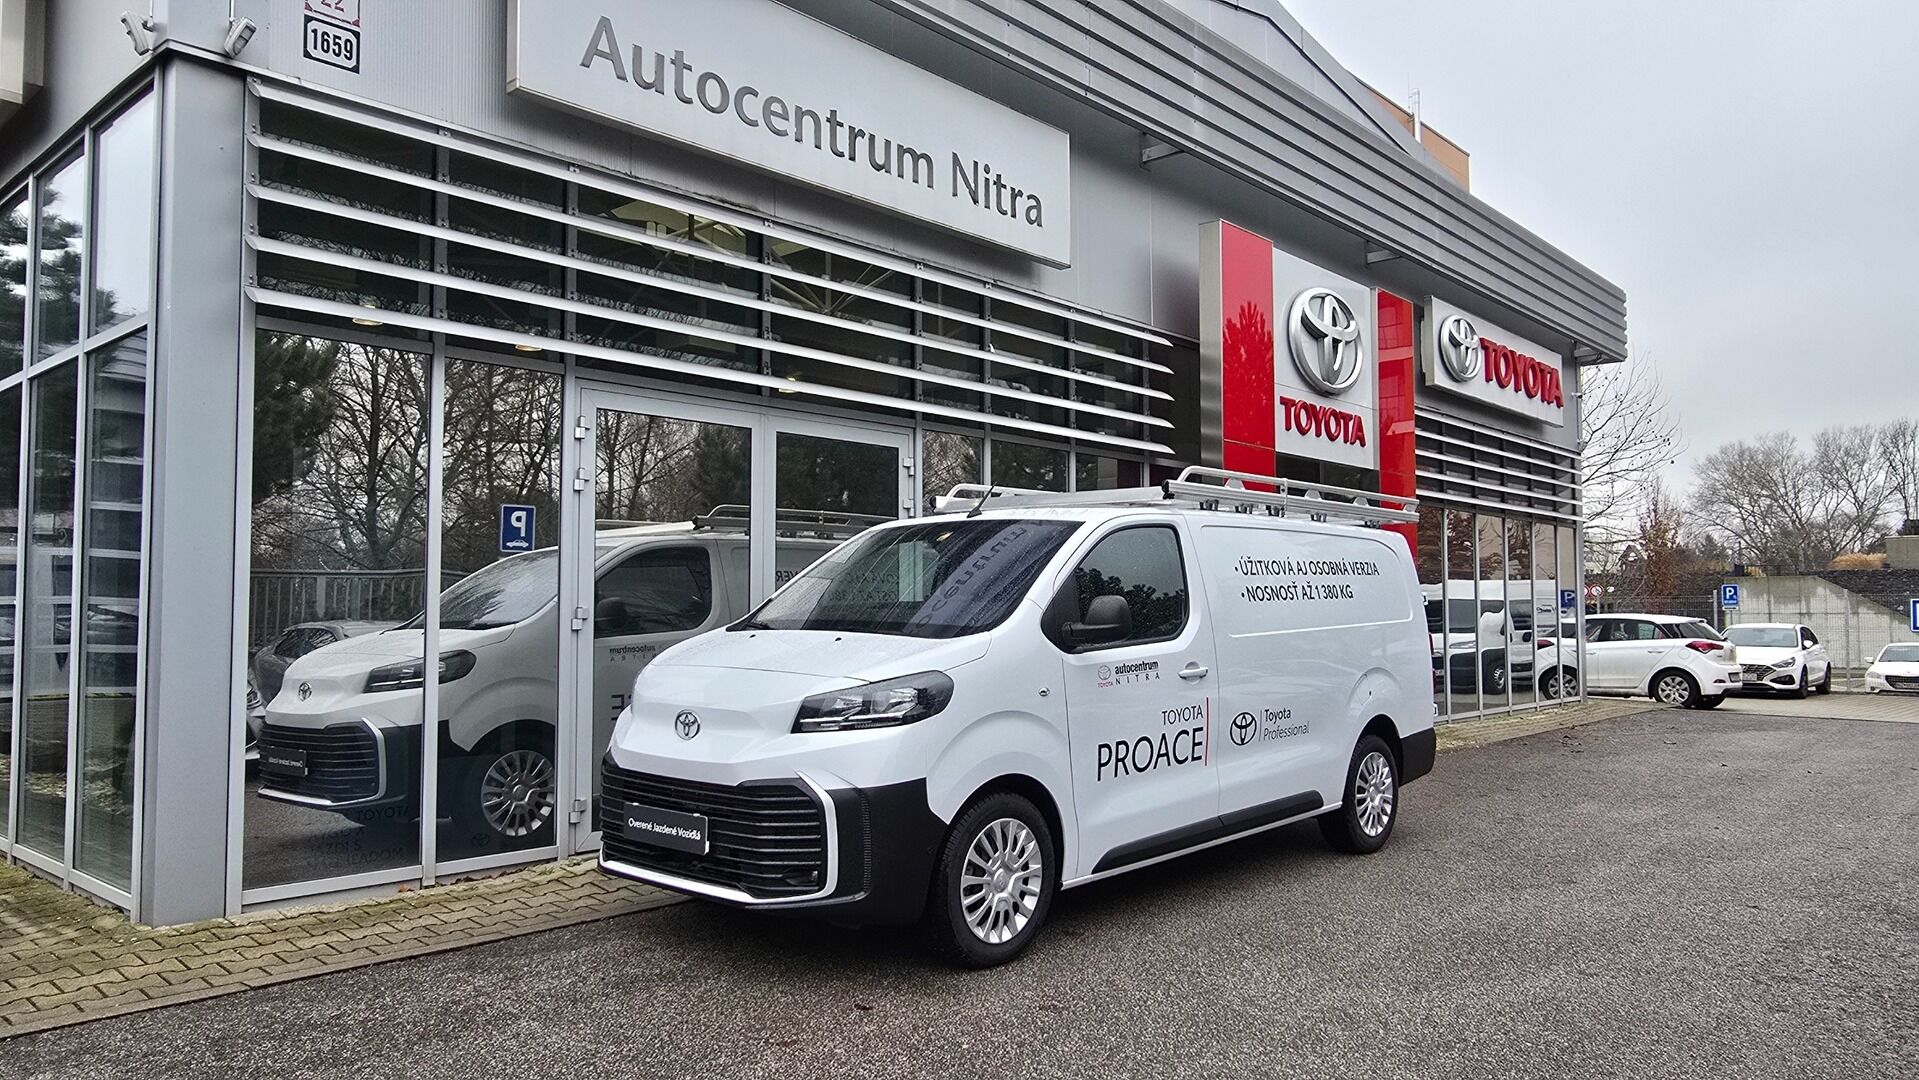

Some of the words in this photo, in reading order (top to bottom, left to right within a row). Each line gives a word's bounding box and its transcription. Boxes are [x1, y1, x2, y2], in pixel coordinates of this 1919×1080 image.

[311, 27, 353, 61] 1659
[579, 15, 934, 190] Autocentrum
[951, 150, 1044, 229] Nitra
[1479, 337, 1564, 408] TOYOTA
[1280, 395, 1367, 448] TOYOTA
[1239, 556, 1295, 576] ÚŽITKOVÁ
[1297, 561, 1307, 576] AJ
[1309, 558, 1349, 576] OSOBNÁ
[1349, 561, 1380, 576] VERZIA
[1246, 581, 1299, 602] NOSNOSŤ
[1302, 581, 1314, 600] AŽ
[1321, 585, 1338, 600] 380
[1340, 585, 1353, 599] KG
[1725, 587, 1734, 599] P
[1114, 660, 1159, 675] autocentrum
[1115, 672, 1160, 685] NITRA
[1161, 704, 1204, 726] TOYOTA
[1264, 708, 1291, 724] Toyota
[1263, 720, 1310, 741] Professional
[1097, 726, 1204, 782] PROACE
[628, 817, 653, 831] Overené
[653, 822, 678, 836] Jazdené
[677, 827, 701, 841] Vozidlá
